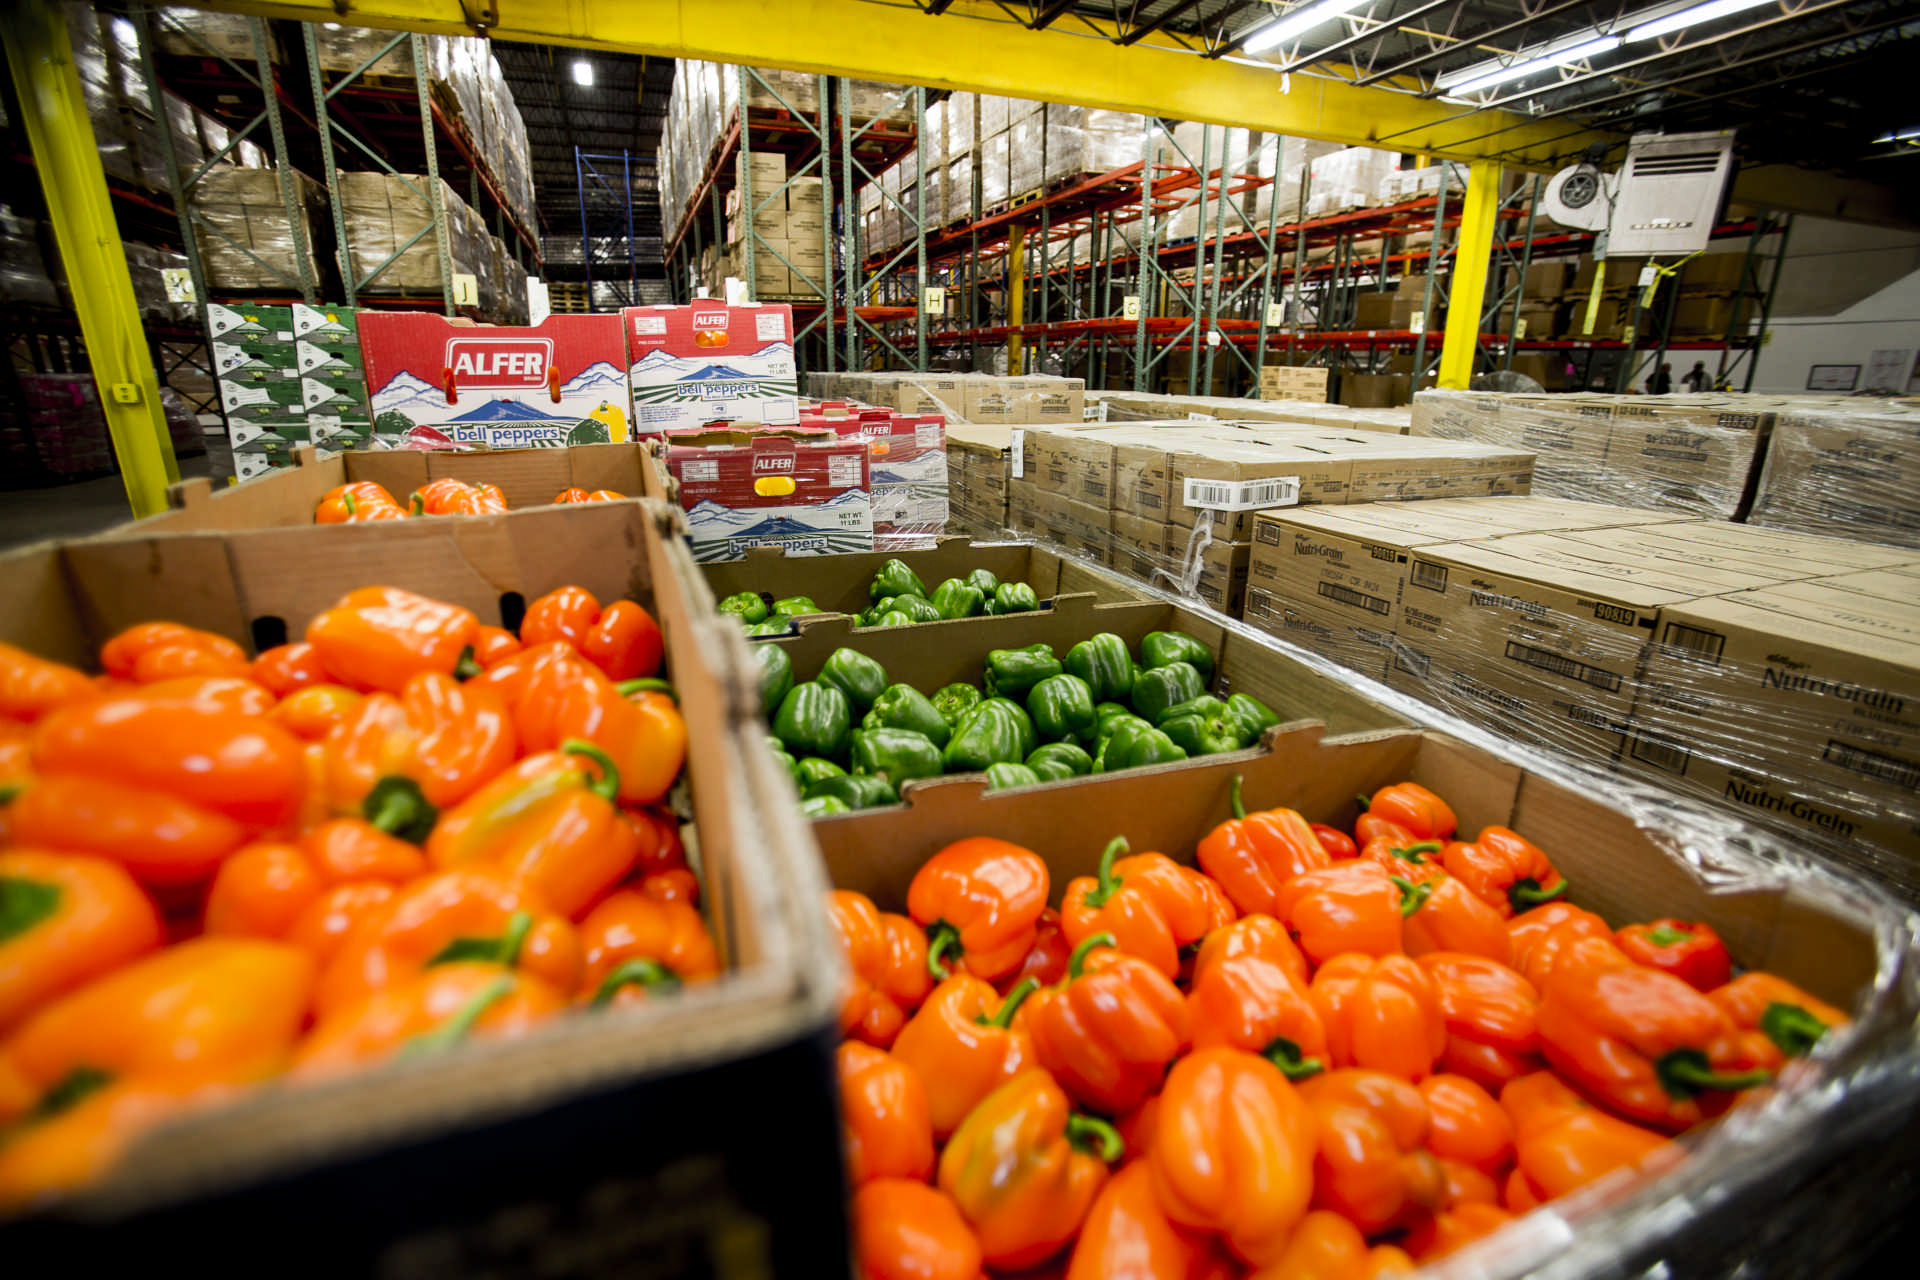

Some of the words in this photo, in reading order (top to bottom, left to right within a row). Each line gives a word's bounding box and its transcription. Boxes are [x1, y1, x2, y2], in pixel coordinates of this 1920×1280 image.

[462, 281, 468, 302] J
[929, 293, 941, 308] H
[695, 315, 727, 326] ALFER
[454, 352, 543, 376] ALFER
[679, 384, 702, 396] bell
[706, 383, 757, 395] peppers
[457, 426, 487, 440] bell
[492, 428, 558, 442] peppers
[863, 426, 889, 435] ALFER
[756, 458, 792, 470] ALFER
[1235, 513, 1245, 532] 4
[763, 538, 825, 551] ppers
[1294, 541, 1343, 561] Nutri-Grain
[1470, 589, 1547, 617] Nutri-Grain
[1596, 602, 1635, 625] 90819
[1762, 666, 1904, 714] Nutri-Grain
[1724, 779, 1855, 838] Nutri-Grain
